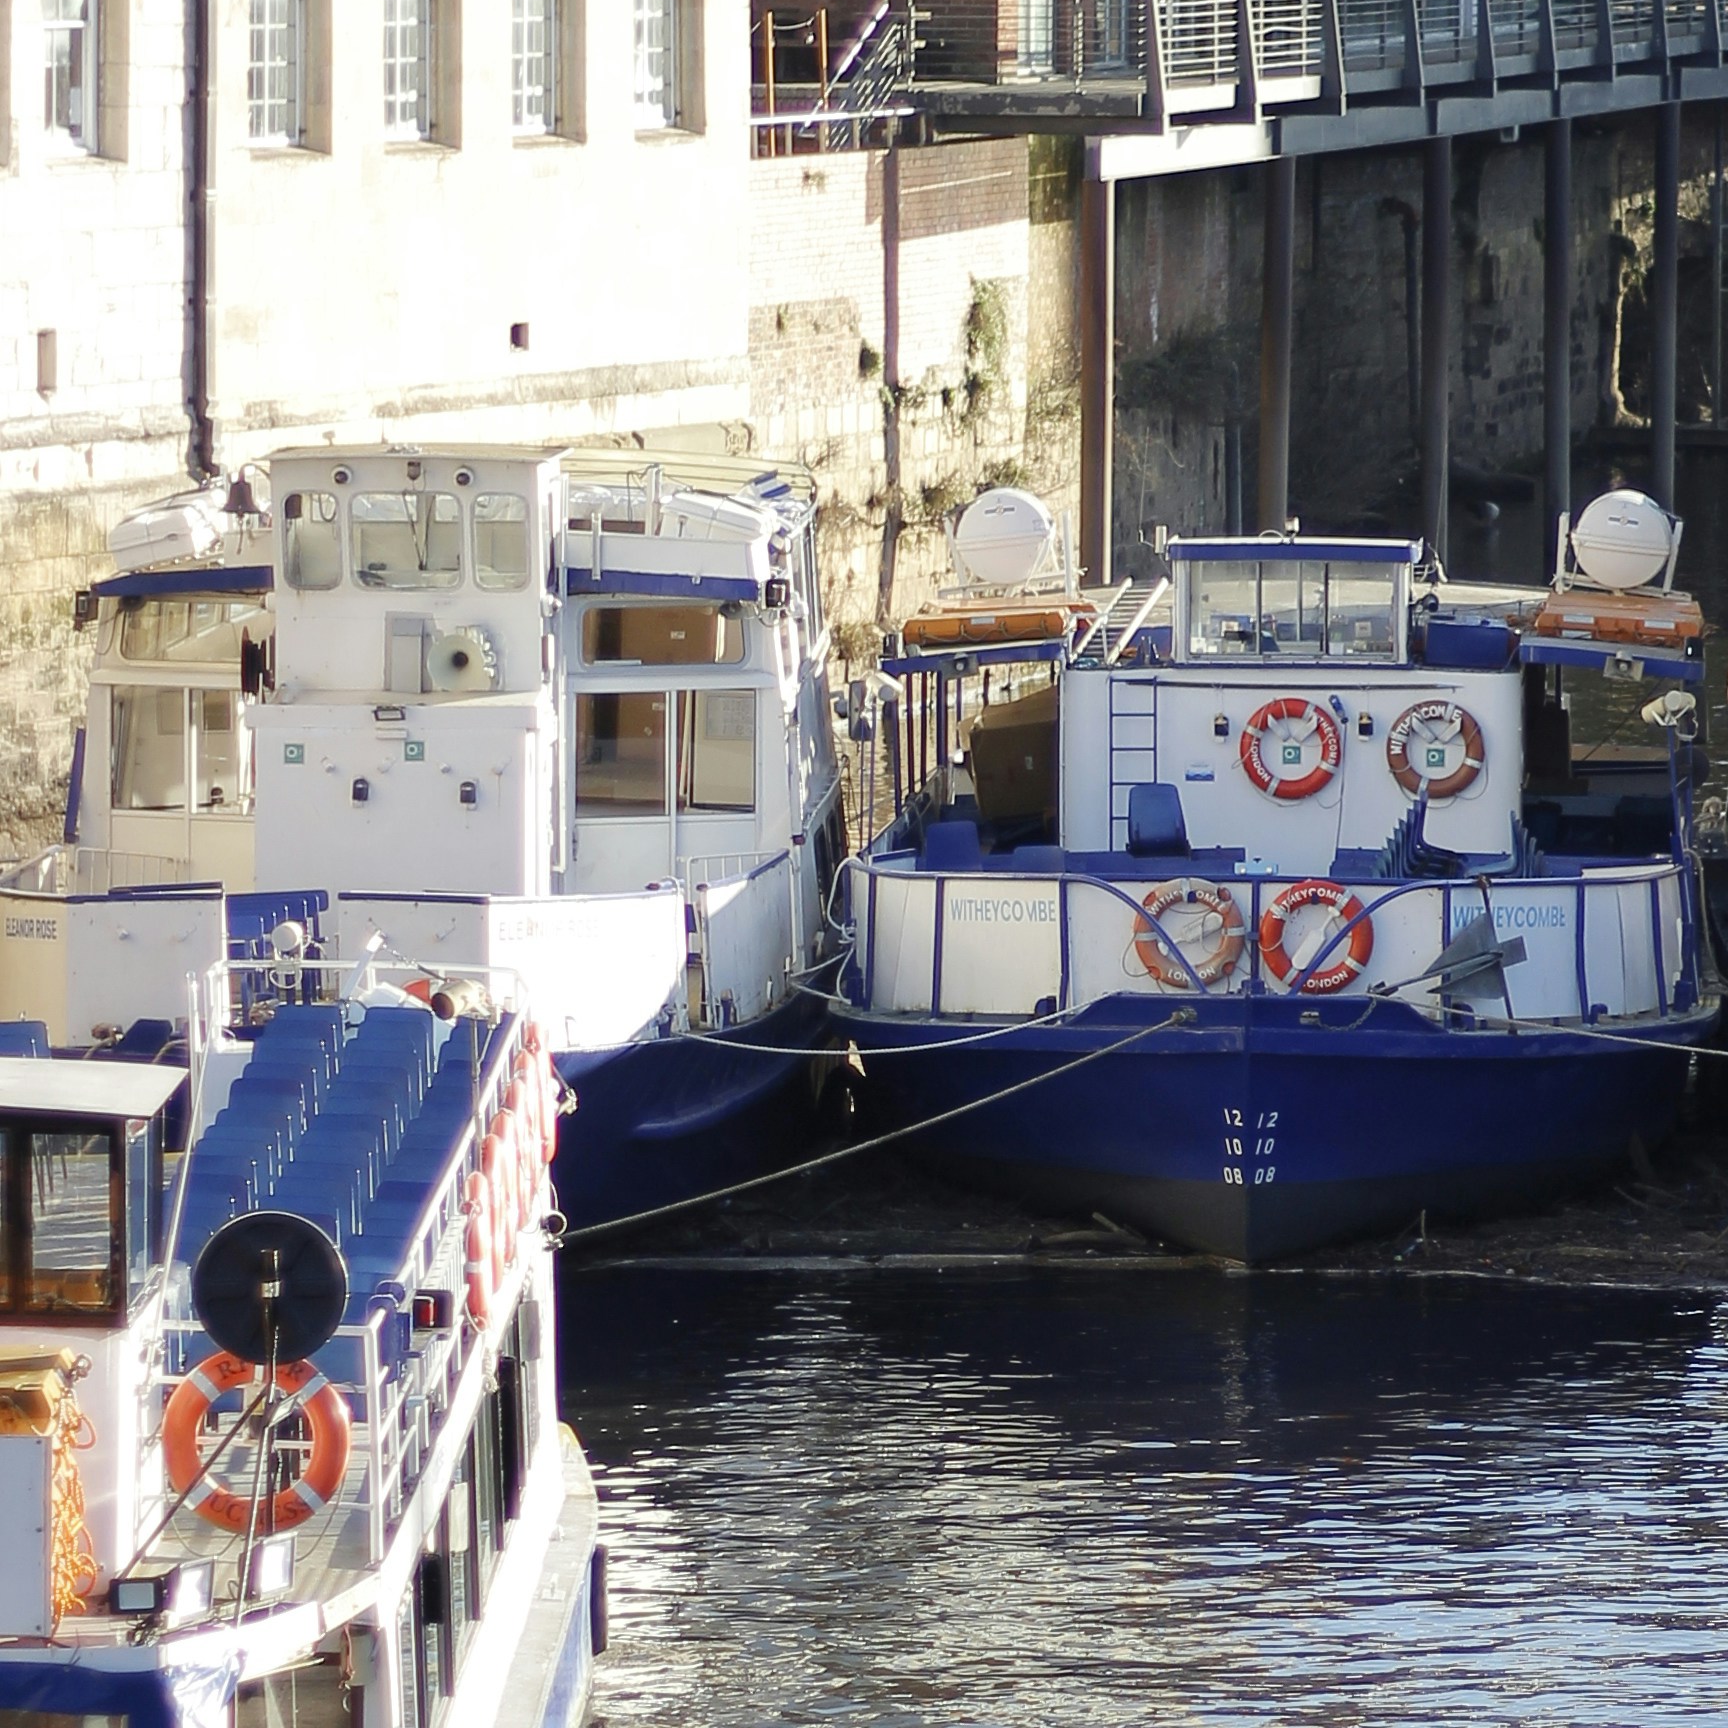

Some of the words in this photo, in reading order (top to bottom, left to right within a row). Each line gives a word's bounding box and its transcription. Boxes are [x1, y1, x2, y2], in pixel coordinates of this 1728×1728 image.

[950, 898, 1057, 922] WITHEYCOMBE
[6, 917, 35, 939] ELEANOR
[36, 919, 57, 940] ROSE
[1167, 965, 1216, 983] LONON
[1303, 969, 1349, 989] ONDON
[1224, 1108, 1244, 1127] 12
[1257, 1111, 1279, 1129] 12
[1225, 1138, 1243, 1155] 10
[1255, 1138, 1275, 1155] 10
[1223, 1166, 1244, 1185] 08
[1255, 1166, 1276, 1185] 08
